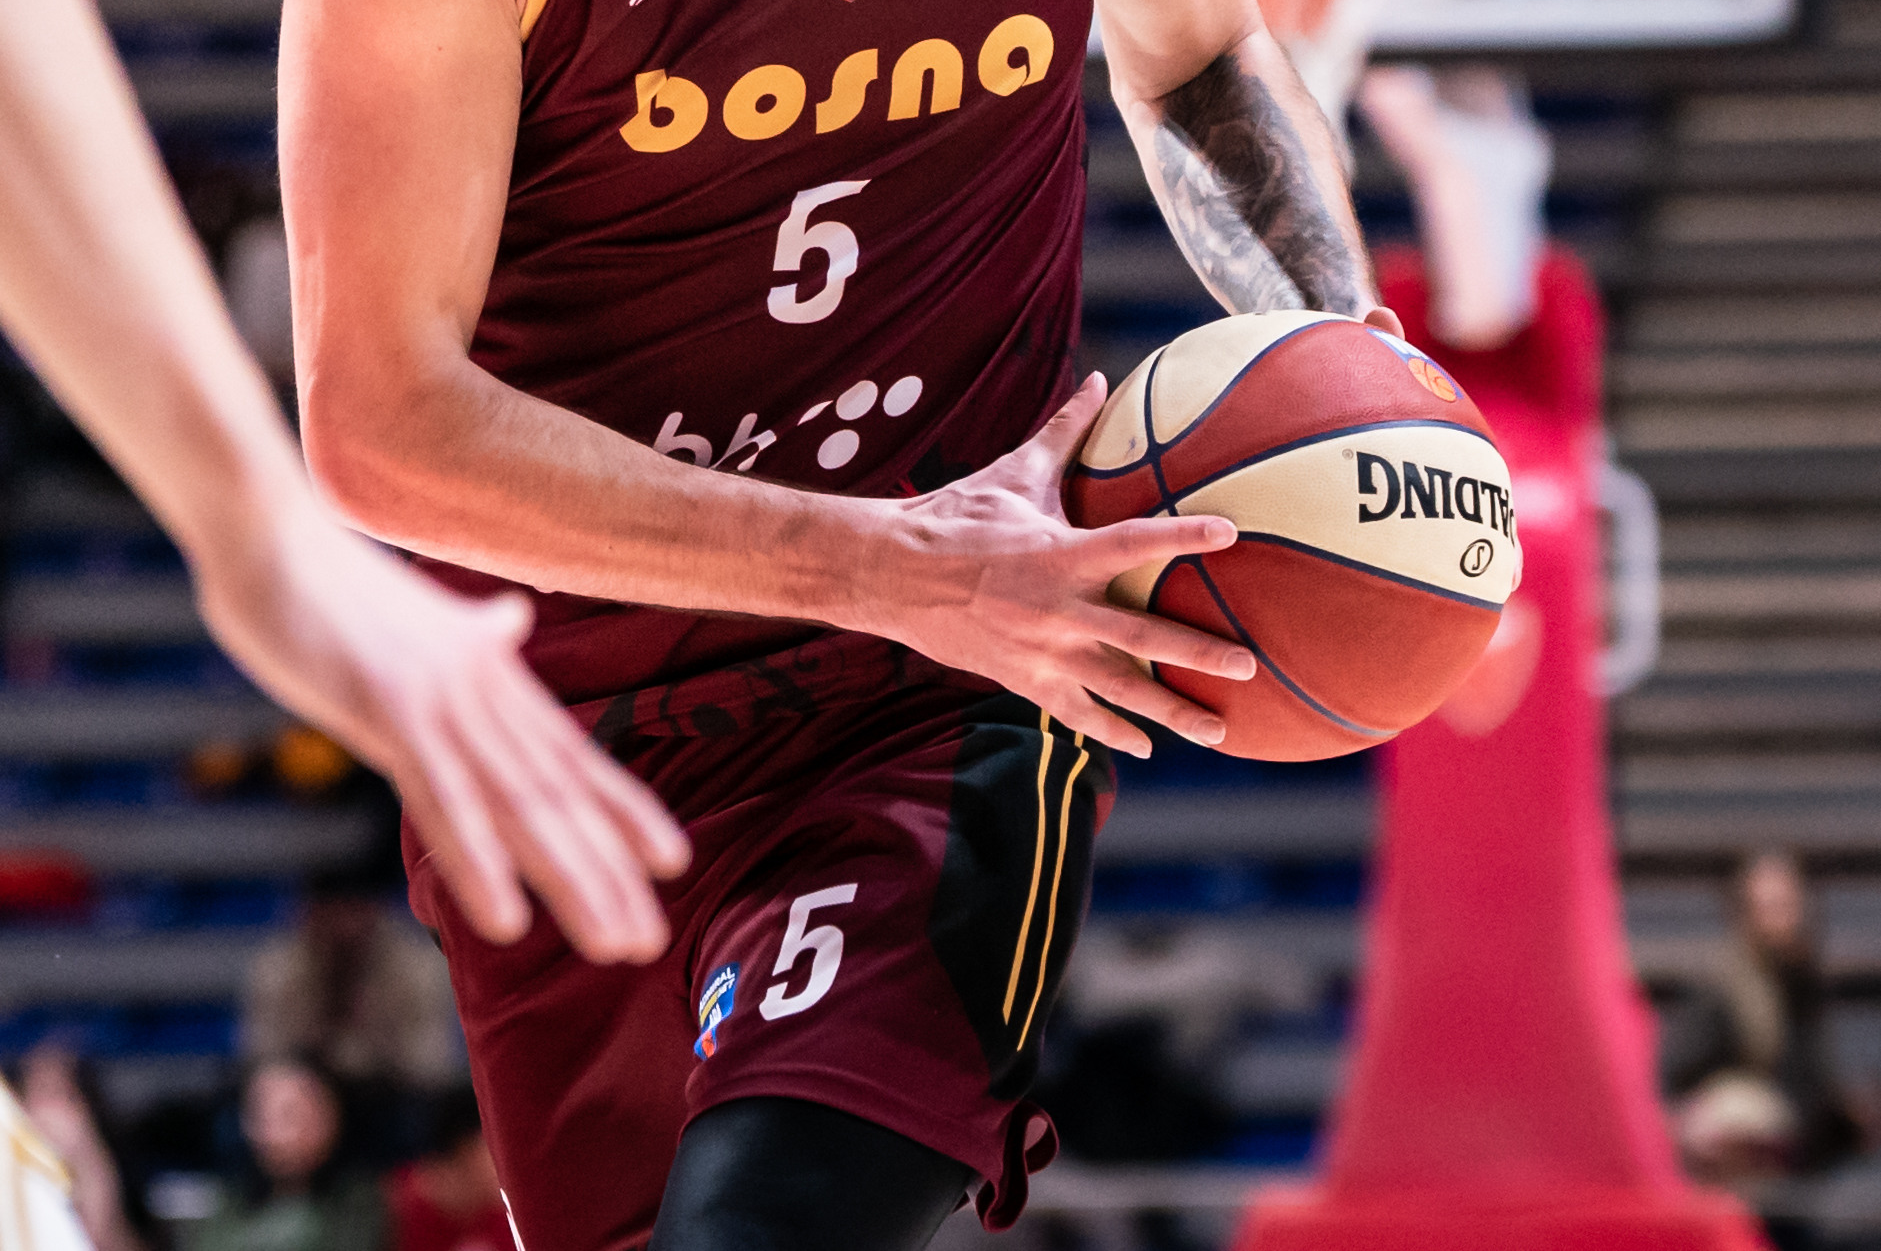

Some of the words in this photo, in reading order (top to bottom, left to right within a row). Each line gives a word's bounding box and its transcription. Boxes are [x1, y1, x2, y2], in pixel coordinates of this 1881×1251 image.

[619, 14, 1055, 153] bosna
[766, 178, 872, 324] 5
[759, 883, 859, 1022] 5
